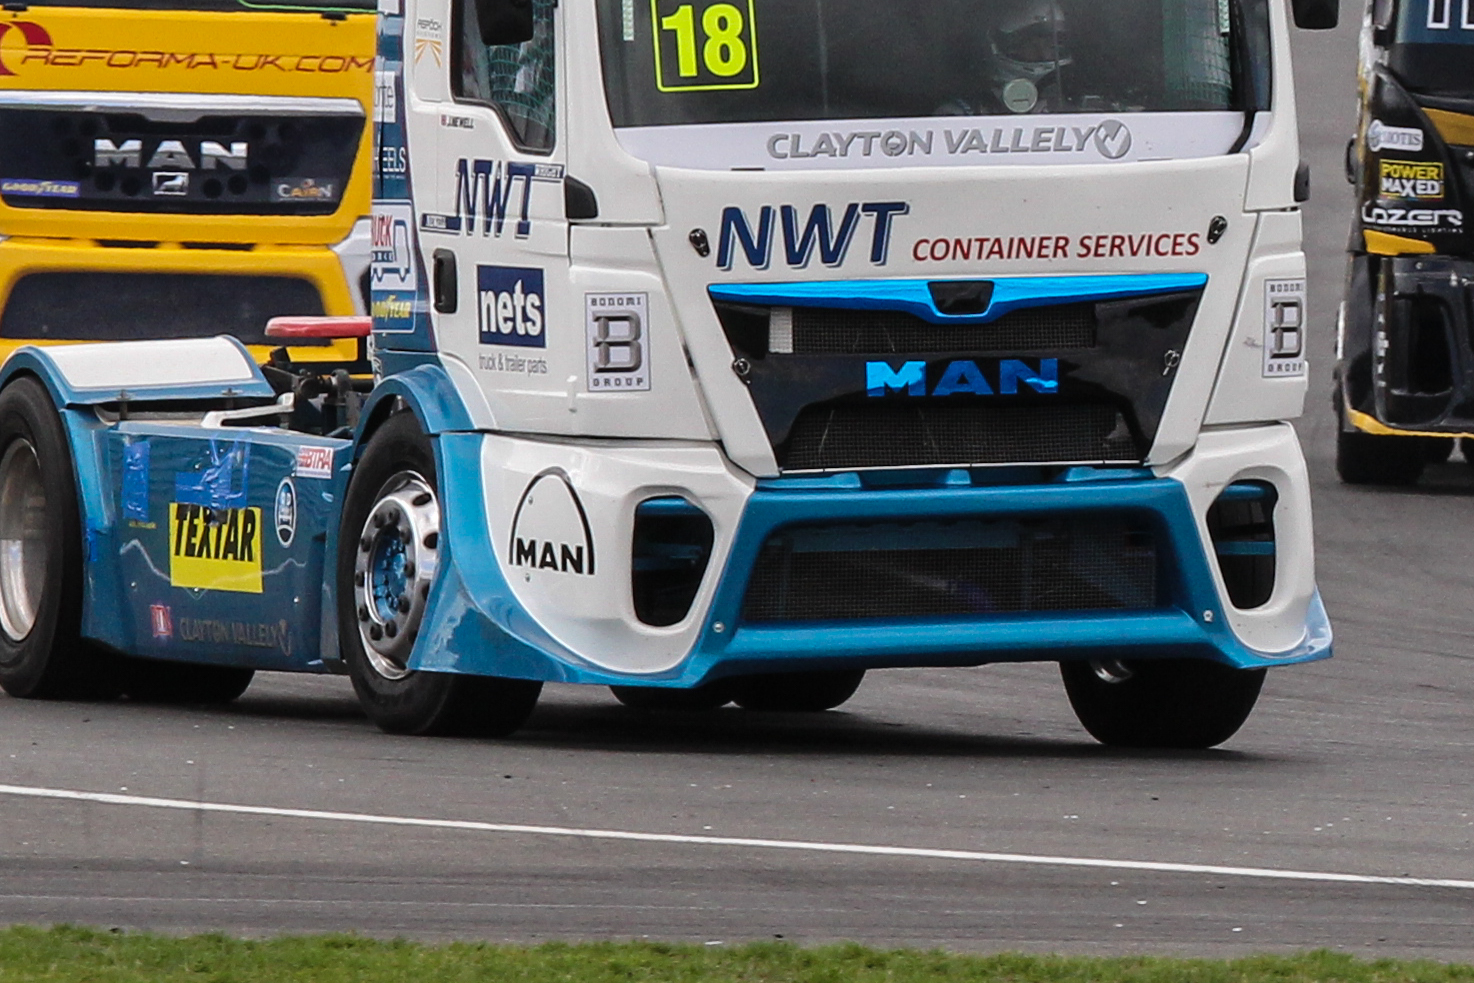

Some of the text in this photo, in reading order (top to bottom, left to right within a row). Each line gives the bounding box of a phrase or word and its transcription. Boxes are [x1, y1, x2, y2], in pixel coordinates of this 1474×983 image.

[661, 3, 747, 78] 18
[95, 139, 248, 169] MAN
[767, 125, 1097, 159] CLAYTON VALLELY
[1381, 163, 1440, 181] POWER
[1381, 178, 1440, 198] MAXED
[455, 158, 535, 240] NWT
[716, 202, 1200, 270] NWT CONTAINER SERVICES
[480, 279, 542, 336] nets
[591, 297, 642, 306] BONOMI
[592, 310, 642, 373] B
[478, 354, 497, 371] truck
[505, 354, 527, 372] trailer
[527, 357, 548, 376] parts
[593, 378, 644, 387] GROUP
[866, 358, 1058, 397] MAN
[175, 504, 256, 562] TEXTAR
[516, 537, 584, 575] MAN
